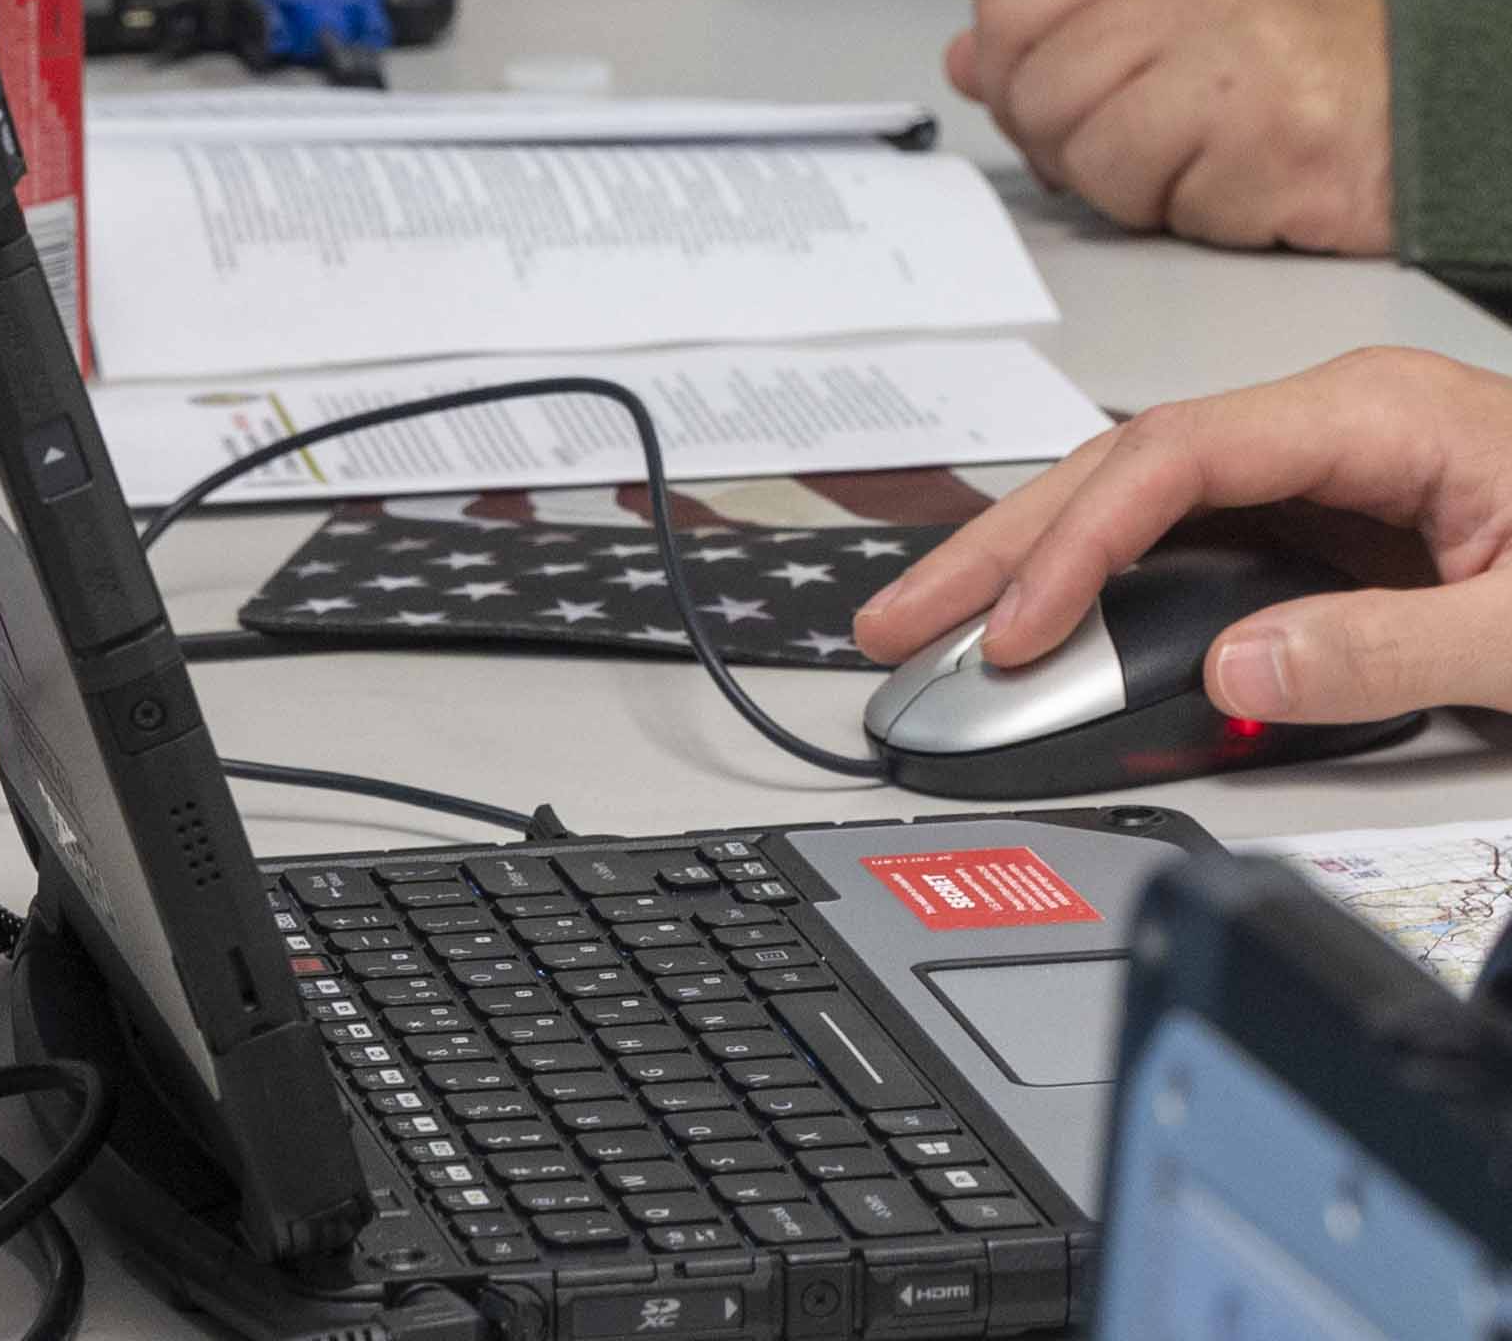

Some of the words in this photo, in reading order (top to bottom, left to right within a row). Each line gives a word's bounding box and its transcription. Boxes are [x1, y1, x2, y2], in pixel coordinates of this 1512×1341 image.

[922, 874, 976, 909] SECRET
[470, 973, 492, 982] O
[577, 984, 598, 992] K
[678, 988, 701, 996] M
[704, 1016, 725, 1024] N
[512, 1030, 533, 1038] U
[618, 1039, 642, 1048] H
[726, 1045, 748, 1053] B
[640, 1068, 663, 1077] G
[748, 1074, 770, 1083] V
[770, 1101, 792, 1110] C
[576, 1115, 600, 1124] R
[689, 1127, 711, 1135] D
[520, 1134, 540, 1142] 4
[797, 1133, 820, 1141] X
[599, 1147, 622, 1155] E
[711, 1157, 734, 1166] S
[542, 1165, 565, 1173] 3
[819, 1164, 844, 1173] Z
[621, 1176, 646, 1186] W
[738, 1188, 758, 1197] A
[565, 1196, 589, 1204] 2
[645, 1209, 669, 1217] Q
[917, 1283, 970, 1302] HDMI
